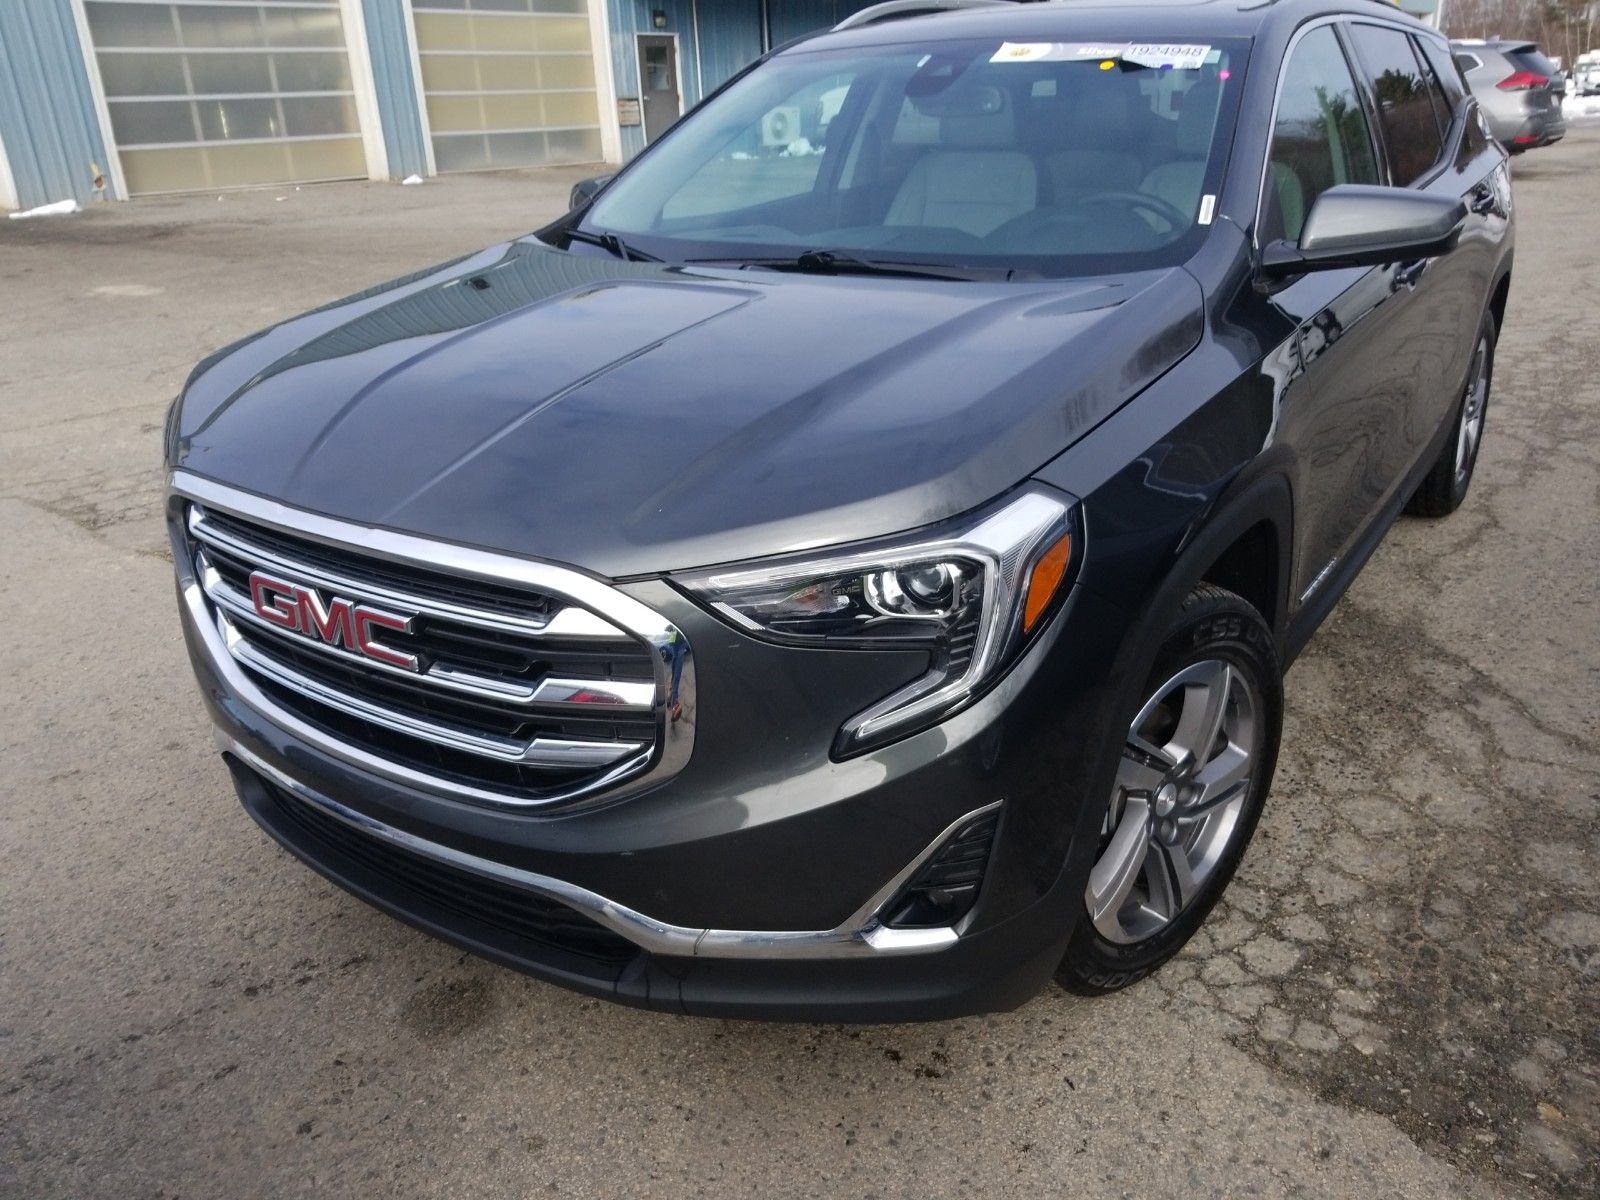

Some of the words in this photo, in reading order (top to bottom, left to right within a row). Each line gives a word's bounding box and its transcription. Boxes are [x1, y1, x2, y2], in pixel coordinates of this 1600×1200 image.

[1131, 46, 1203, 57] 1924948
[832, 585, 860, 596] GMC
[249, 570, 419, 673] GMC
